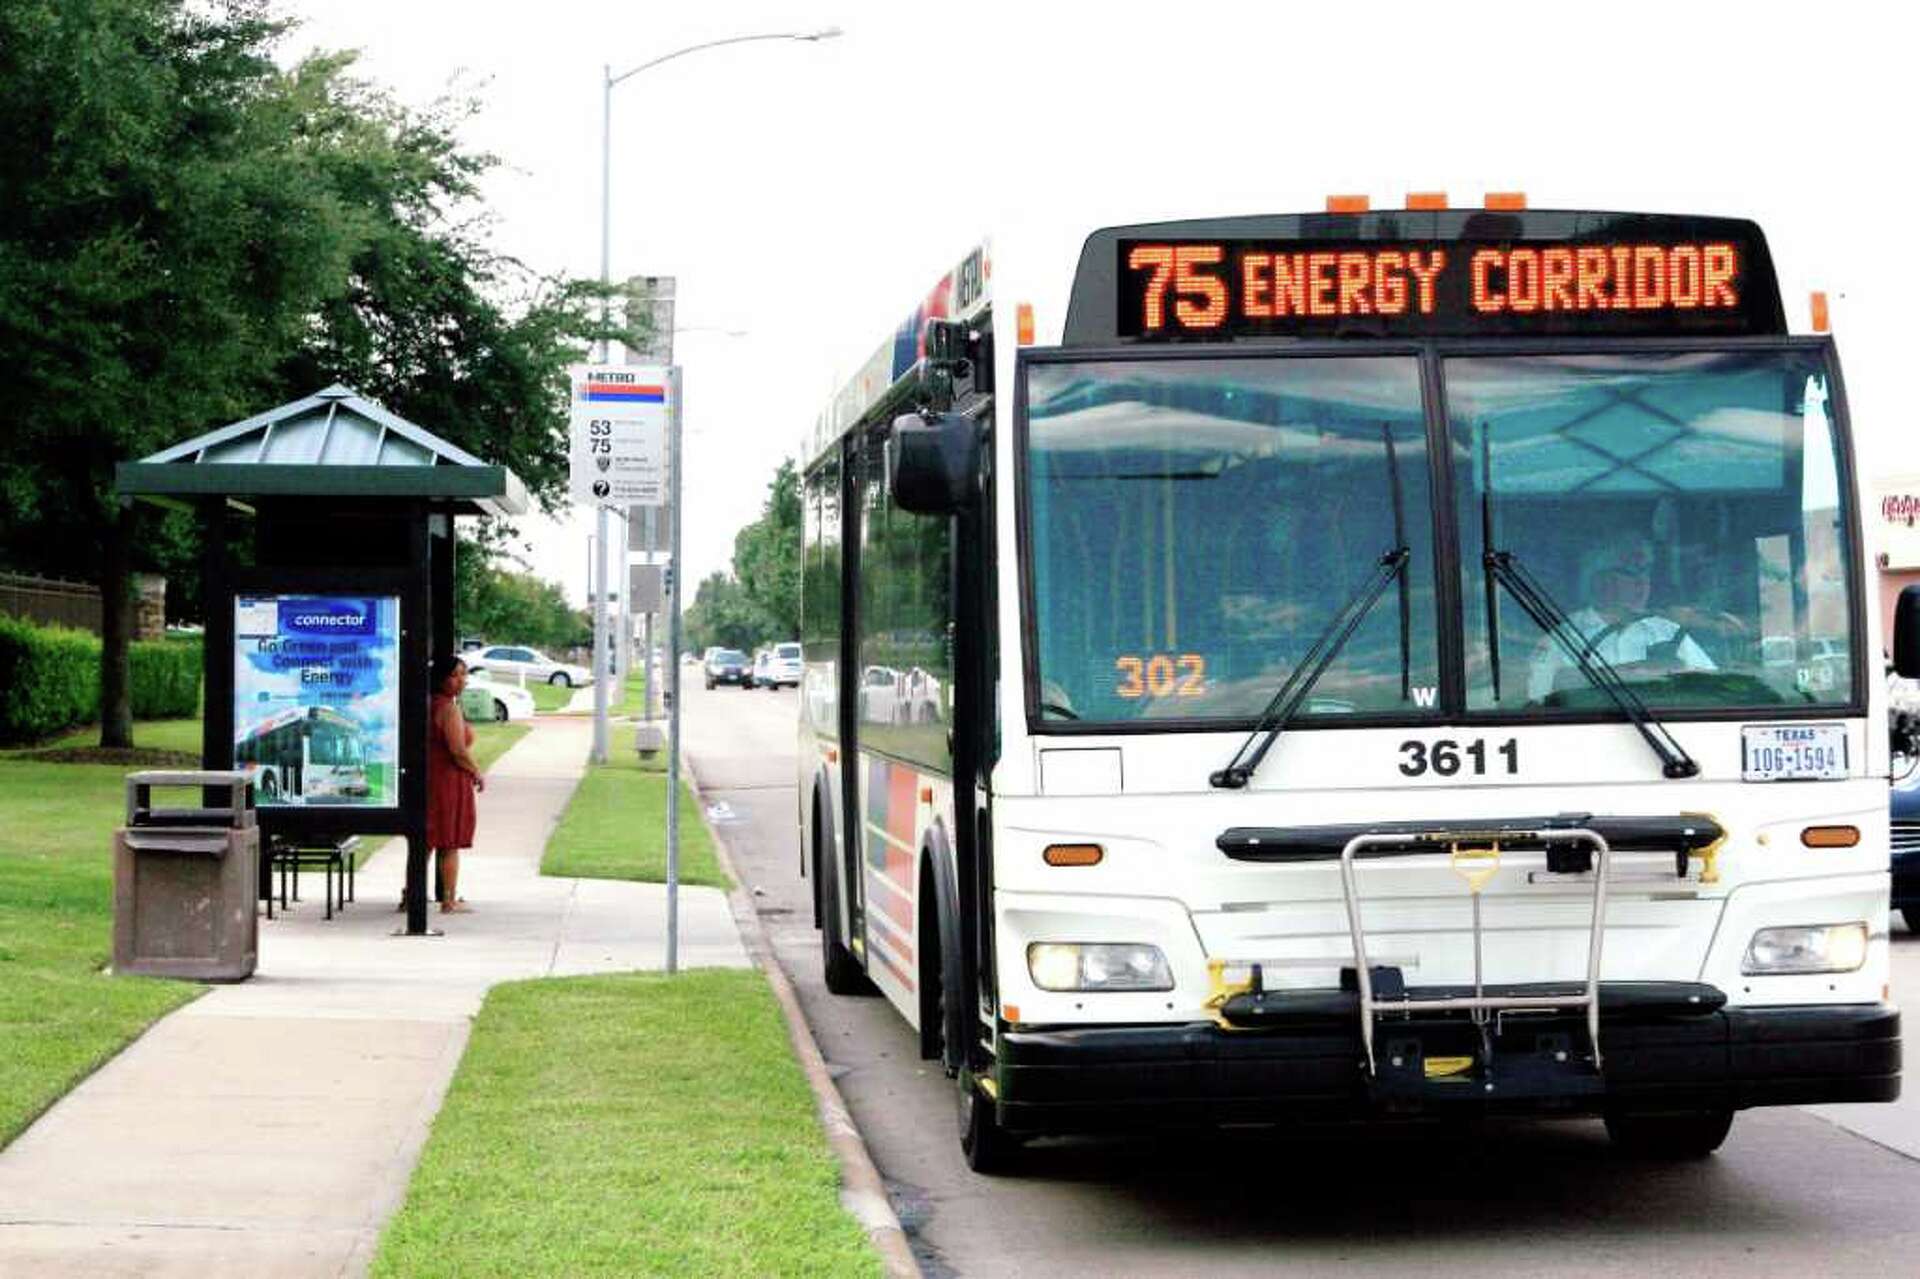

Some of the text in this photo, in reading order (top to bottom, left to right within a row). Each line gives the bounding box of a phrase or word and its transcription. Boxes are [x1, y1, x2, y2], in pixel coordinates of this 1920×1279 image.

[1128, 243, 1739, 330] 75 ENERGY CORRIDOR
[587, 372, 635, 384] METRO
[590, 419, 611, 436] 53
[590, 437, 611, 454] 75
[294, 614, 366, 627] connector
[301, 668, 354, 687] Energy
[1115, 653, 1206, 698] 302
[1411, 687, 1437, 708] W
[1775, 730, 1815, 741] TEXAS
[1398, 737, 1519, 777] 3611
